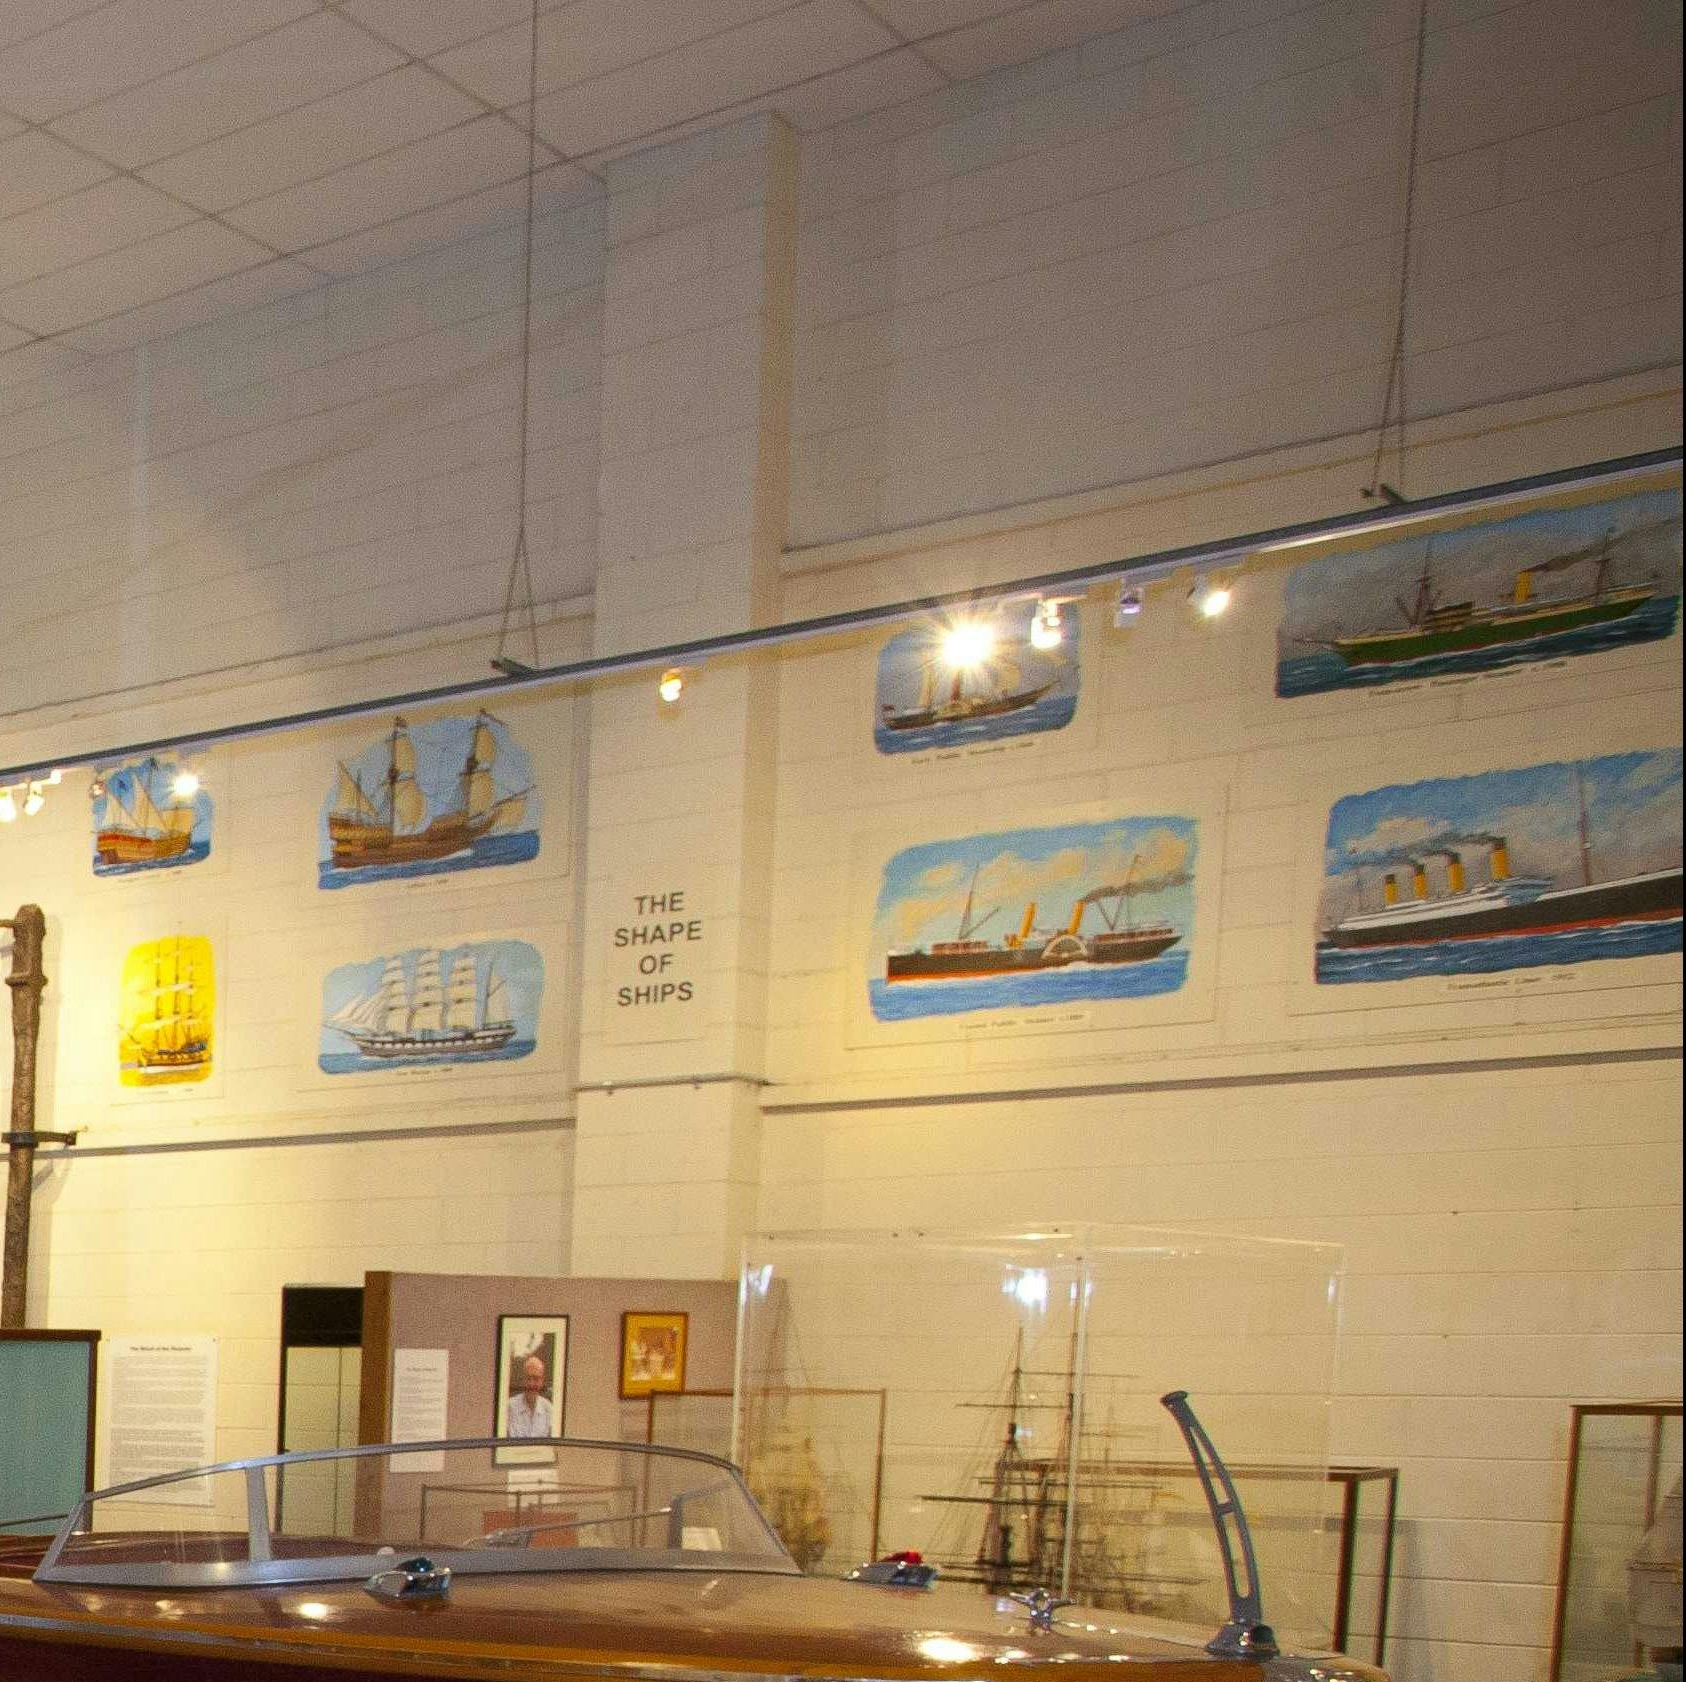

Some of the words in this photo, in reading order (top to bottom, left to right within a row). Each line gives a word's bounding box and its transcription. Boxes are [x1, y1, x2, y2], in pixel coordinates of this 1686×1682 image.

[634, 891, 685, 916] THE
[614, 919, 703, 948] SHAPE
[639, 953, 674, 976] OF
[617, 981, 694, 1007] SHIPS
